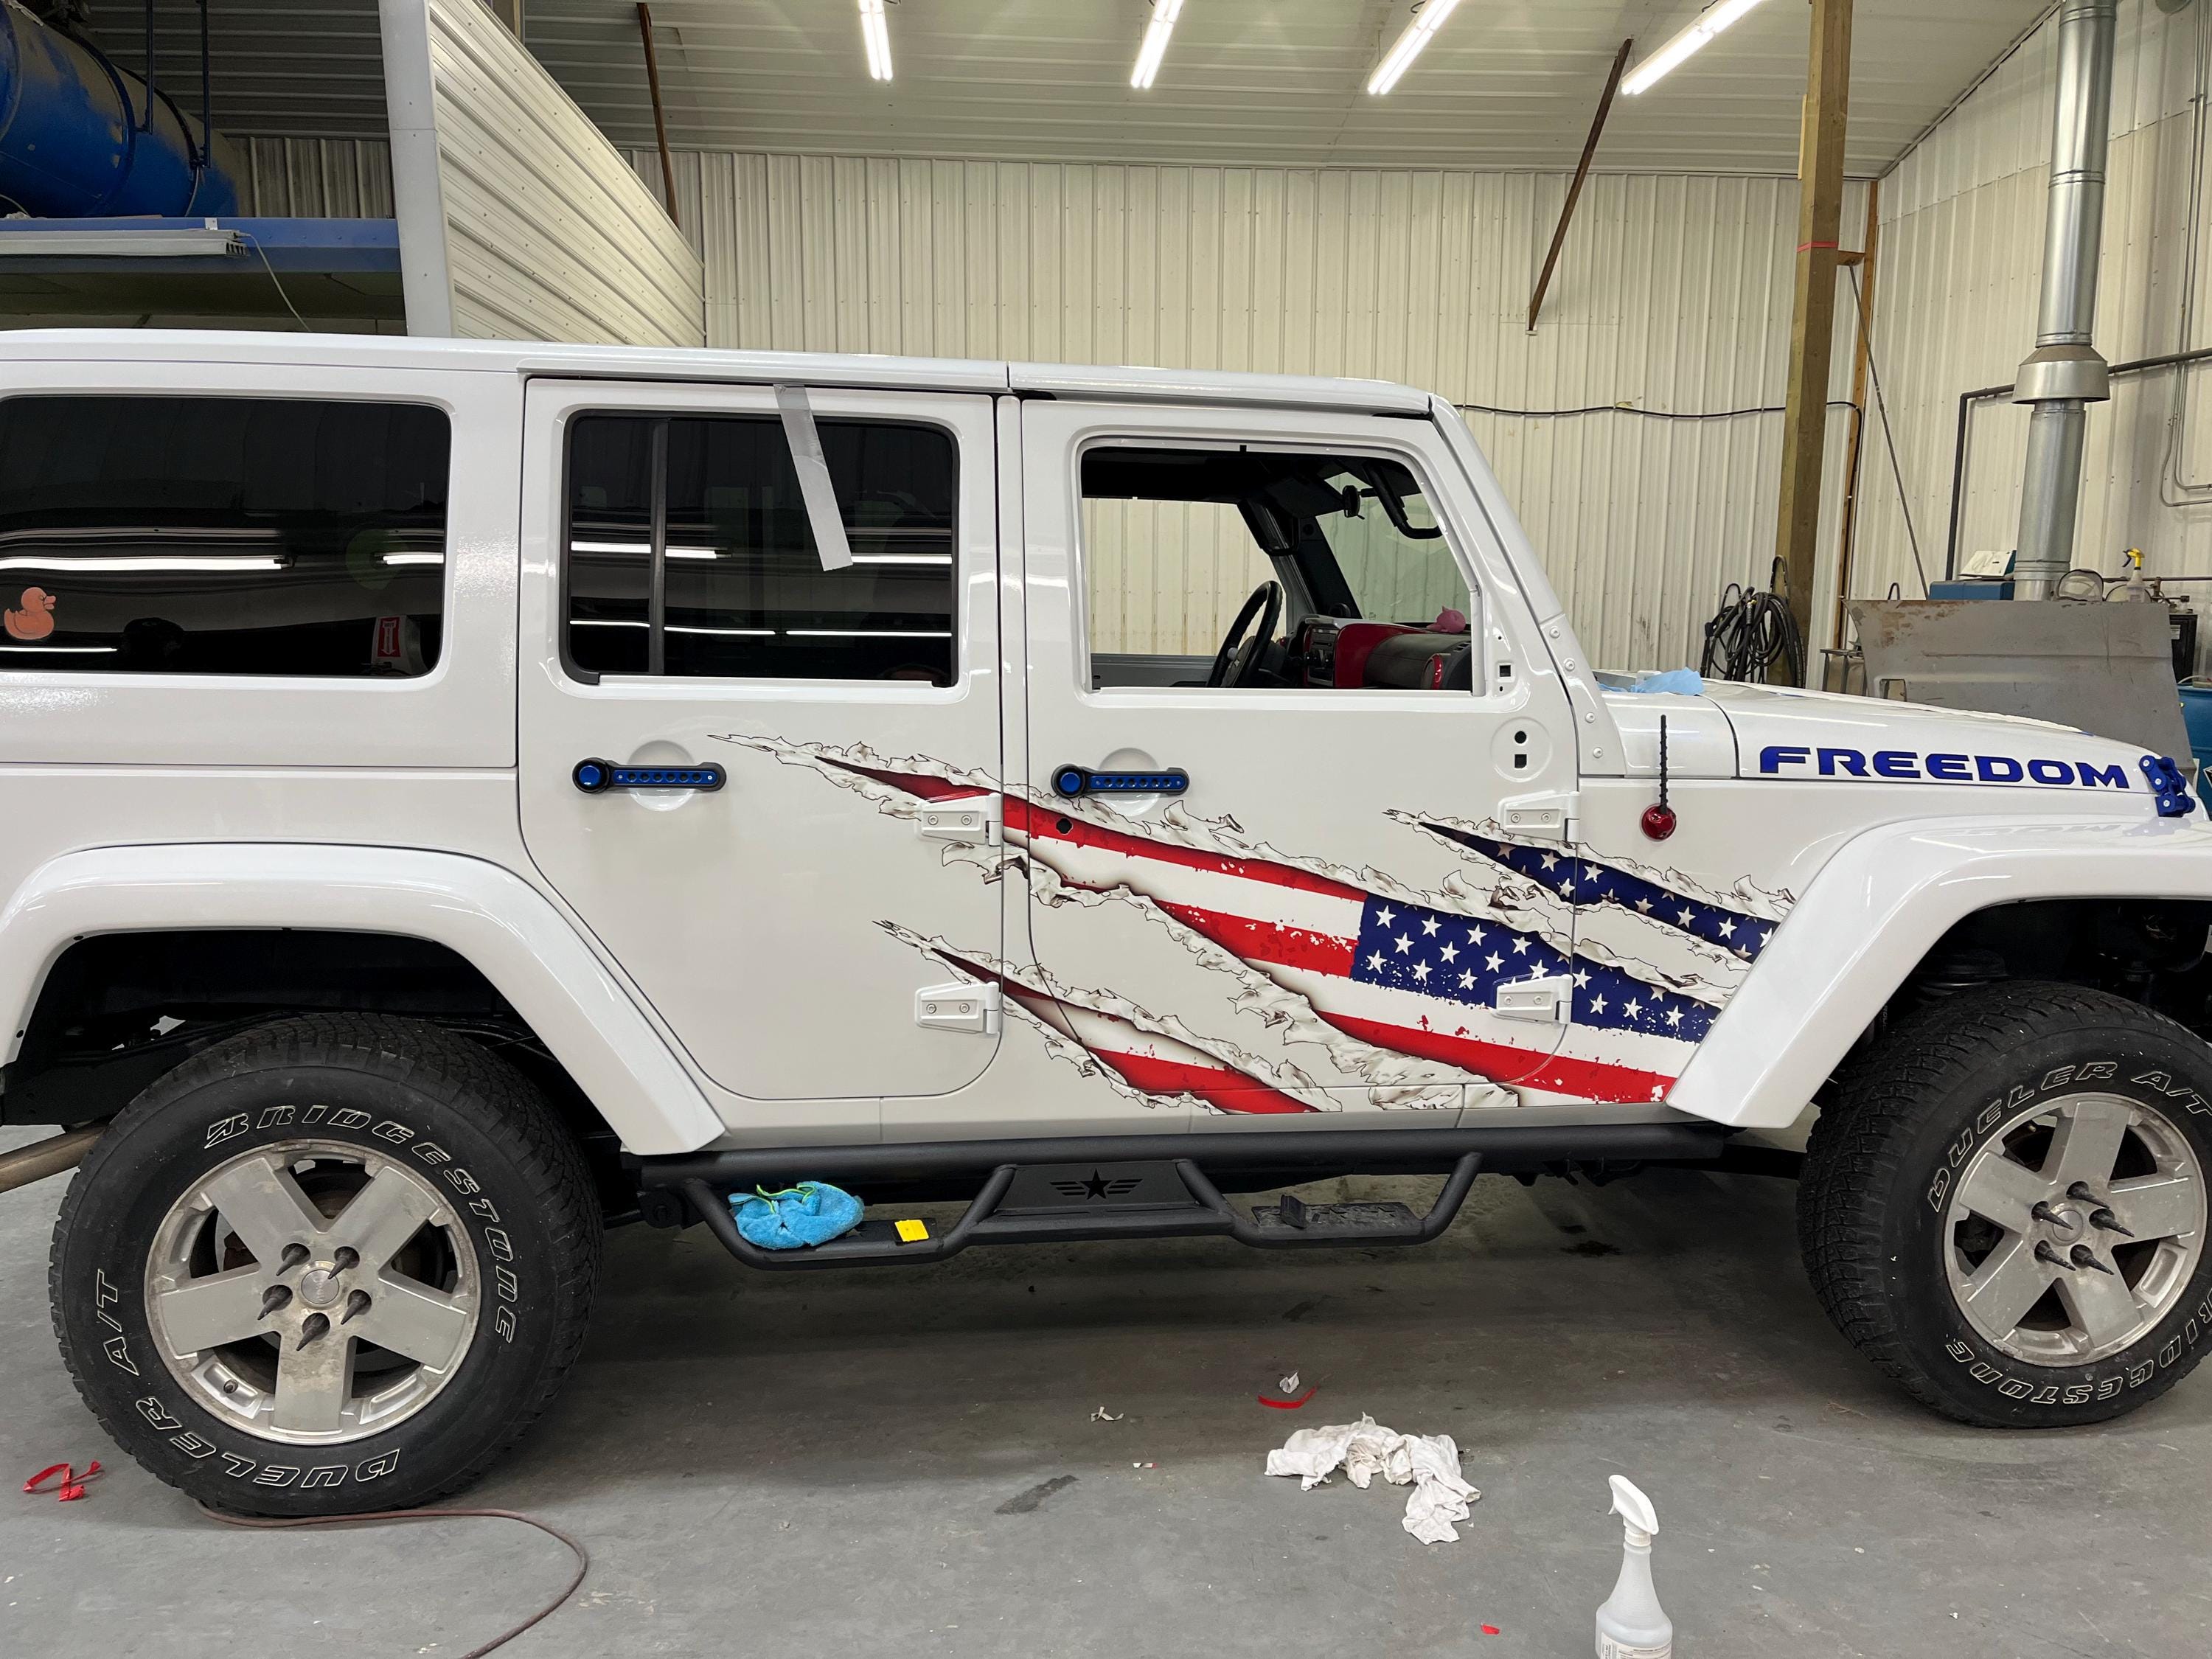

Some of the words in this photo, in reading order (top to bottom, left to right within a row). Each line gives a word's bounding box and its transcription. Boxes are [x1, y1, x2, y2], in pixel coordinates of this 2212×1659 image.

[1759, 745, 2130, 789] FREEDOM
[1927, 1062, 2118, 1213] DUELER
[2131, 1071, 2212, 1115] A/T
[204, 1105, 517, 1343] BRIDGESTONE
[97, 1269, 139, 1377] A/T
[1944, 1289, 2212, 1405] RIDGESTONE
[136, 1398, 400, 1488] DUELER
